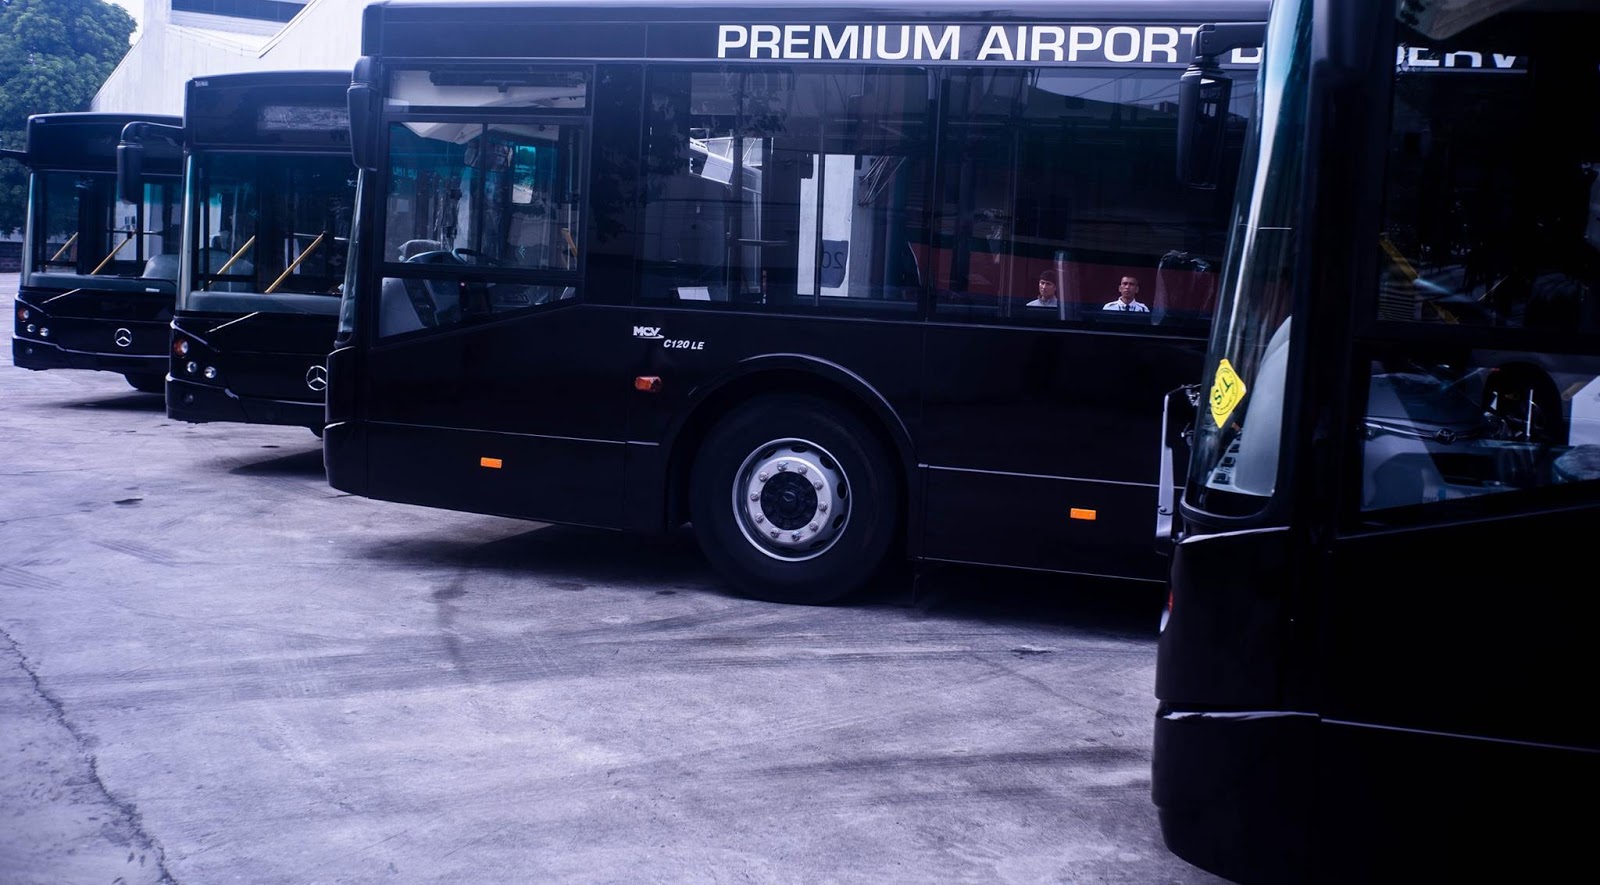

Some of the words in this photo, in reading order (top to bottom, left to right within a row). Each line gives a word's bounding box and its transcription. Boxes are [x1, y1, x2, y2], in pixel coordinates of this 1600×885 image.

[717, 25, 960, 60] PREMIUM
[632, 325, 664, 339] MCV
[663, 339, 690, 349] C120
[690, 341, 705, 350] LE
